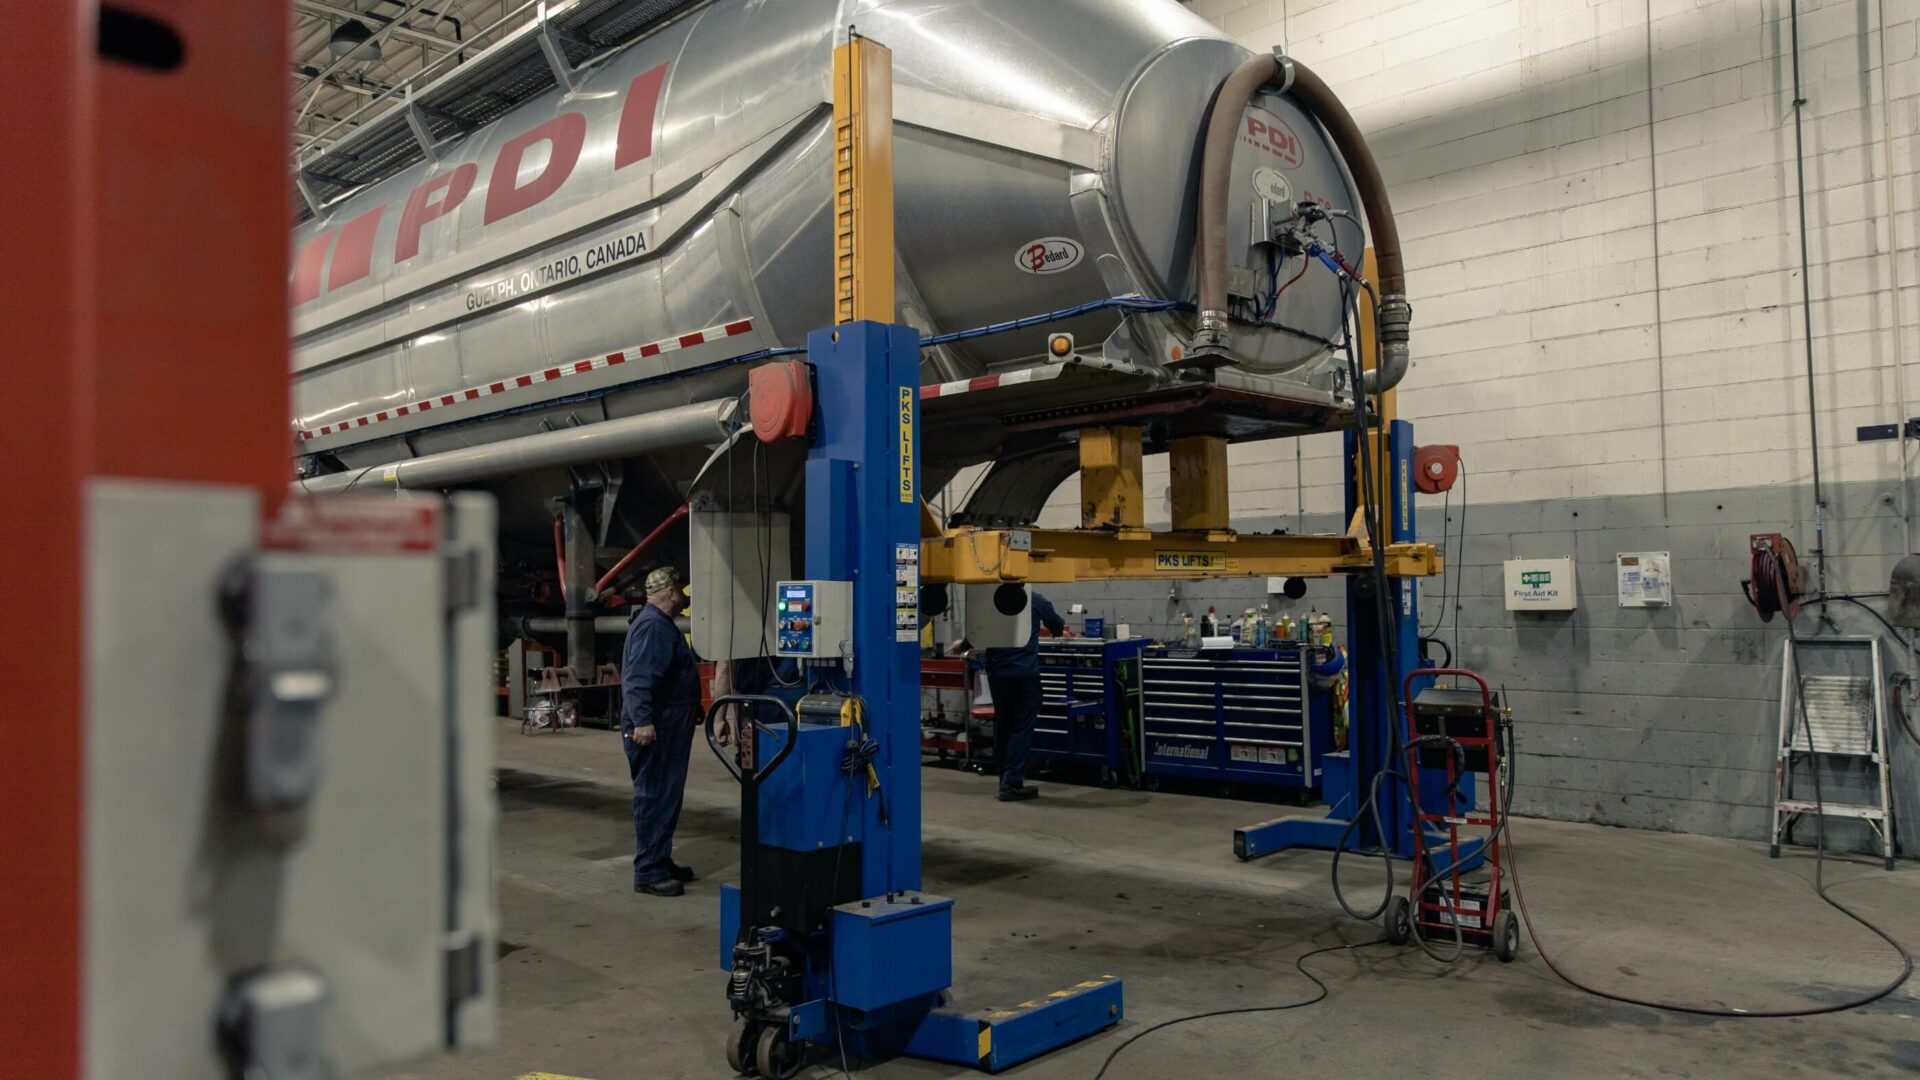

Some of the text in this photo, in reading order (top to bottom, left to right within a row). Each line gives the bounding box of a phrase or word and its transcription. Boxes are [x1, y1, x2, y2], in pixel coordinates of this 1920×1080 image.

[1247, 116, 1296, 155] PDI
[394, 61, 670, 263] PDI
[520, 255, 582, 292] ONTARIO,
[586, 232, 647, 269] CANADA
[1027, 243, 1069, 273] Bedard
[901, 389, 911, 425] PKS
[902, 431, 911, 491] LIFTS
[1158, 554, 1179, 567] PKS
[1182, 554, 1210, 567] LIFTS
